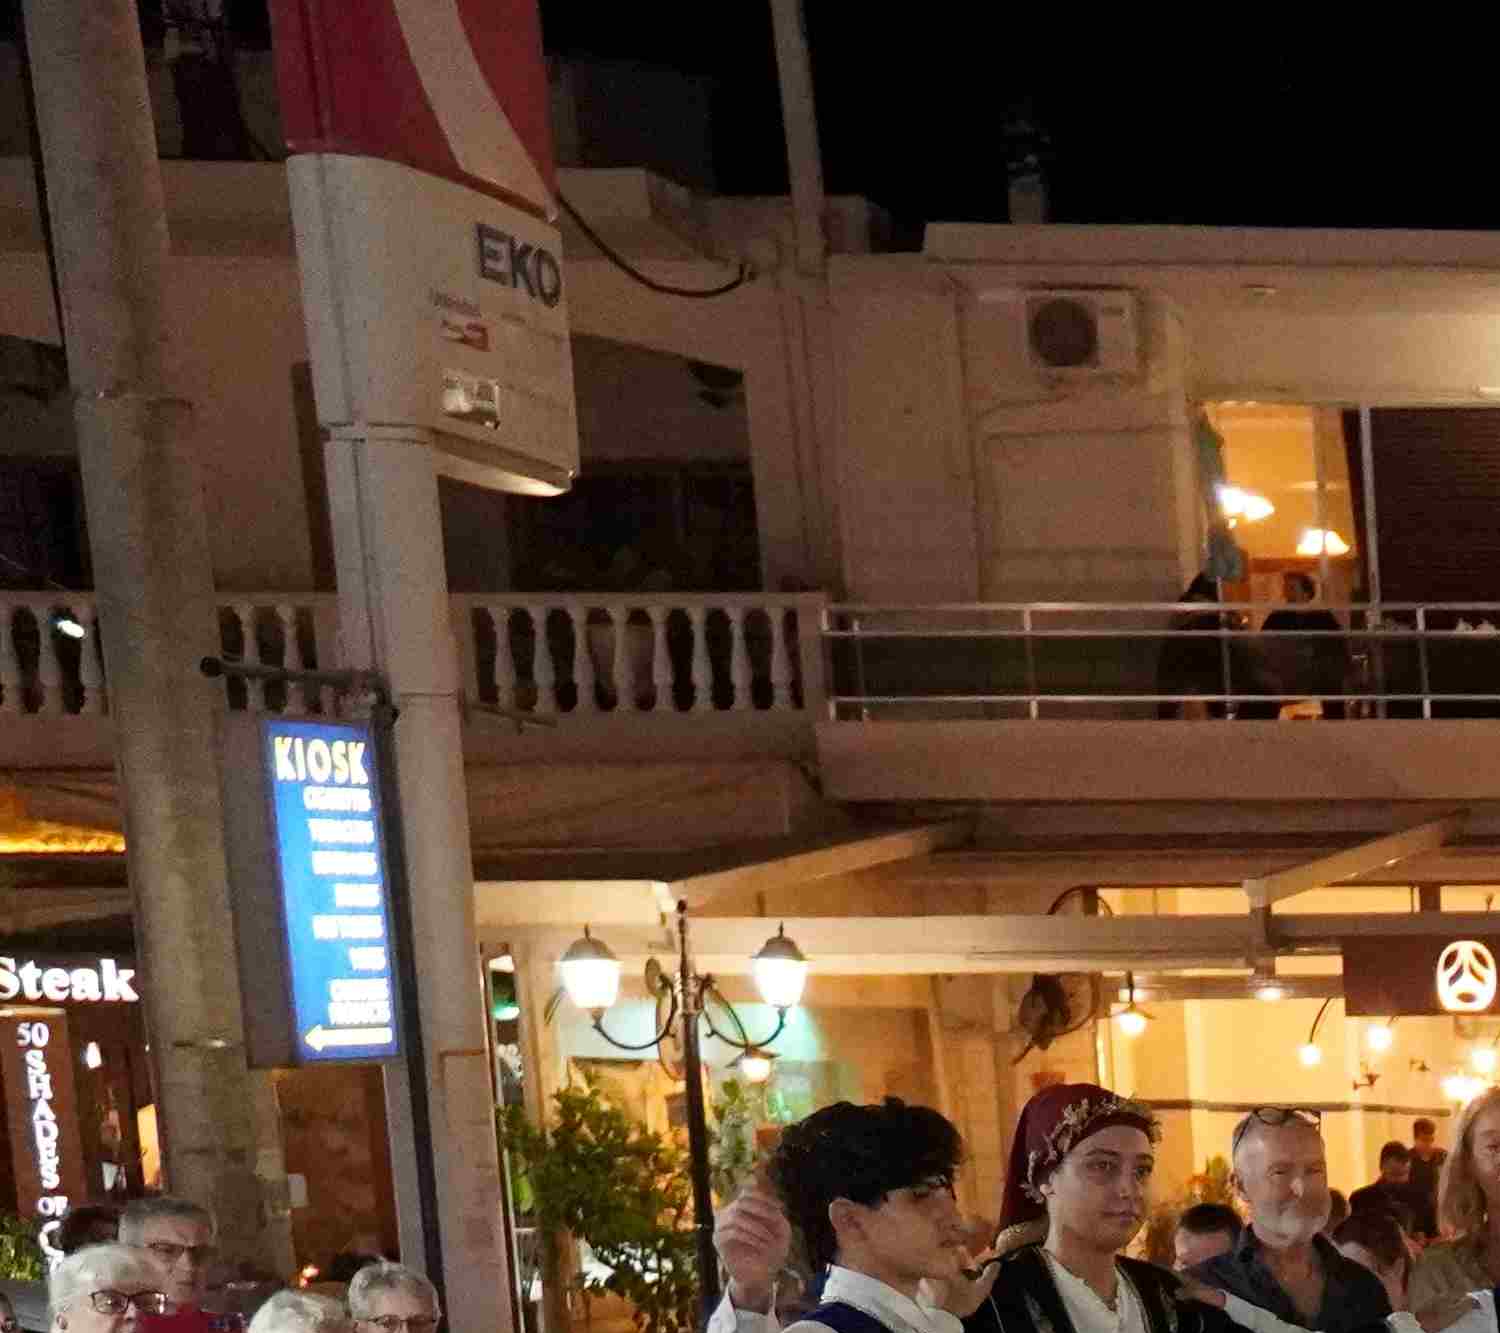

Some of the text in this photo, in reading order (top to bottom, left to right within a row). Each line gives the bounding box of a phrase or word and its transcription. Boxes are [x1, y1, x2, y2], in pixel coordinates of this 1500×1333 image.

[475, 223, 562, 308] EKO
[274, 736, 369, 785] KIOSK
[0, 957, 139, 1001] Steak
[16, 1022, 49, 1048] 50
[25, 1049, 61, 1190] SHADES
